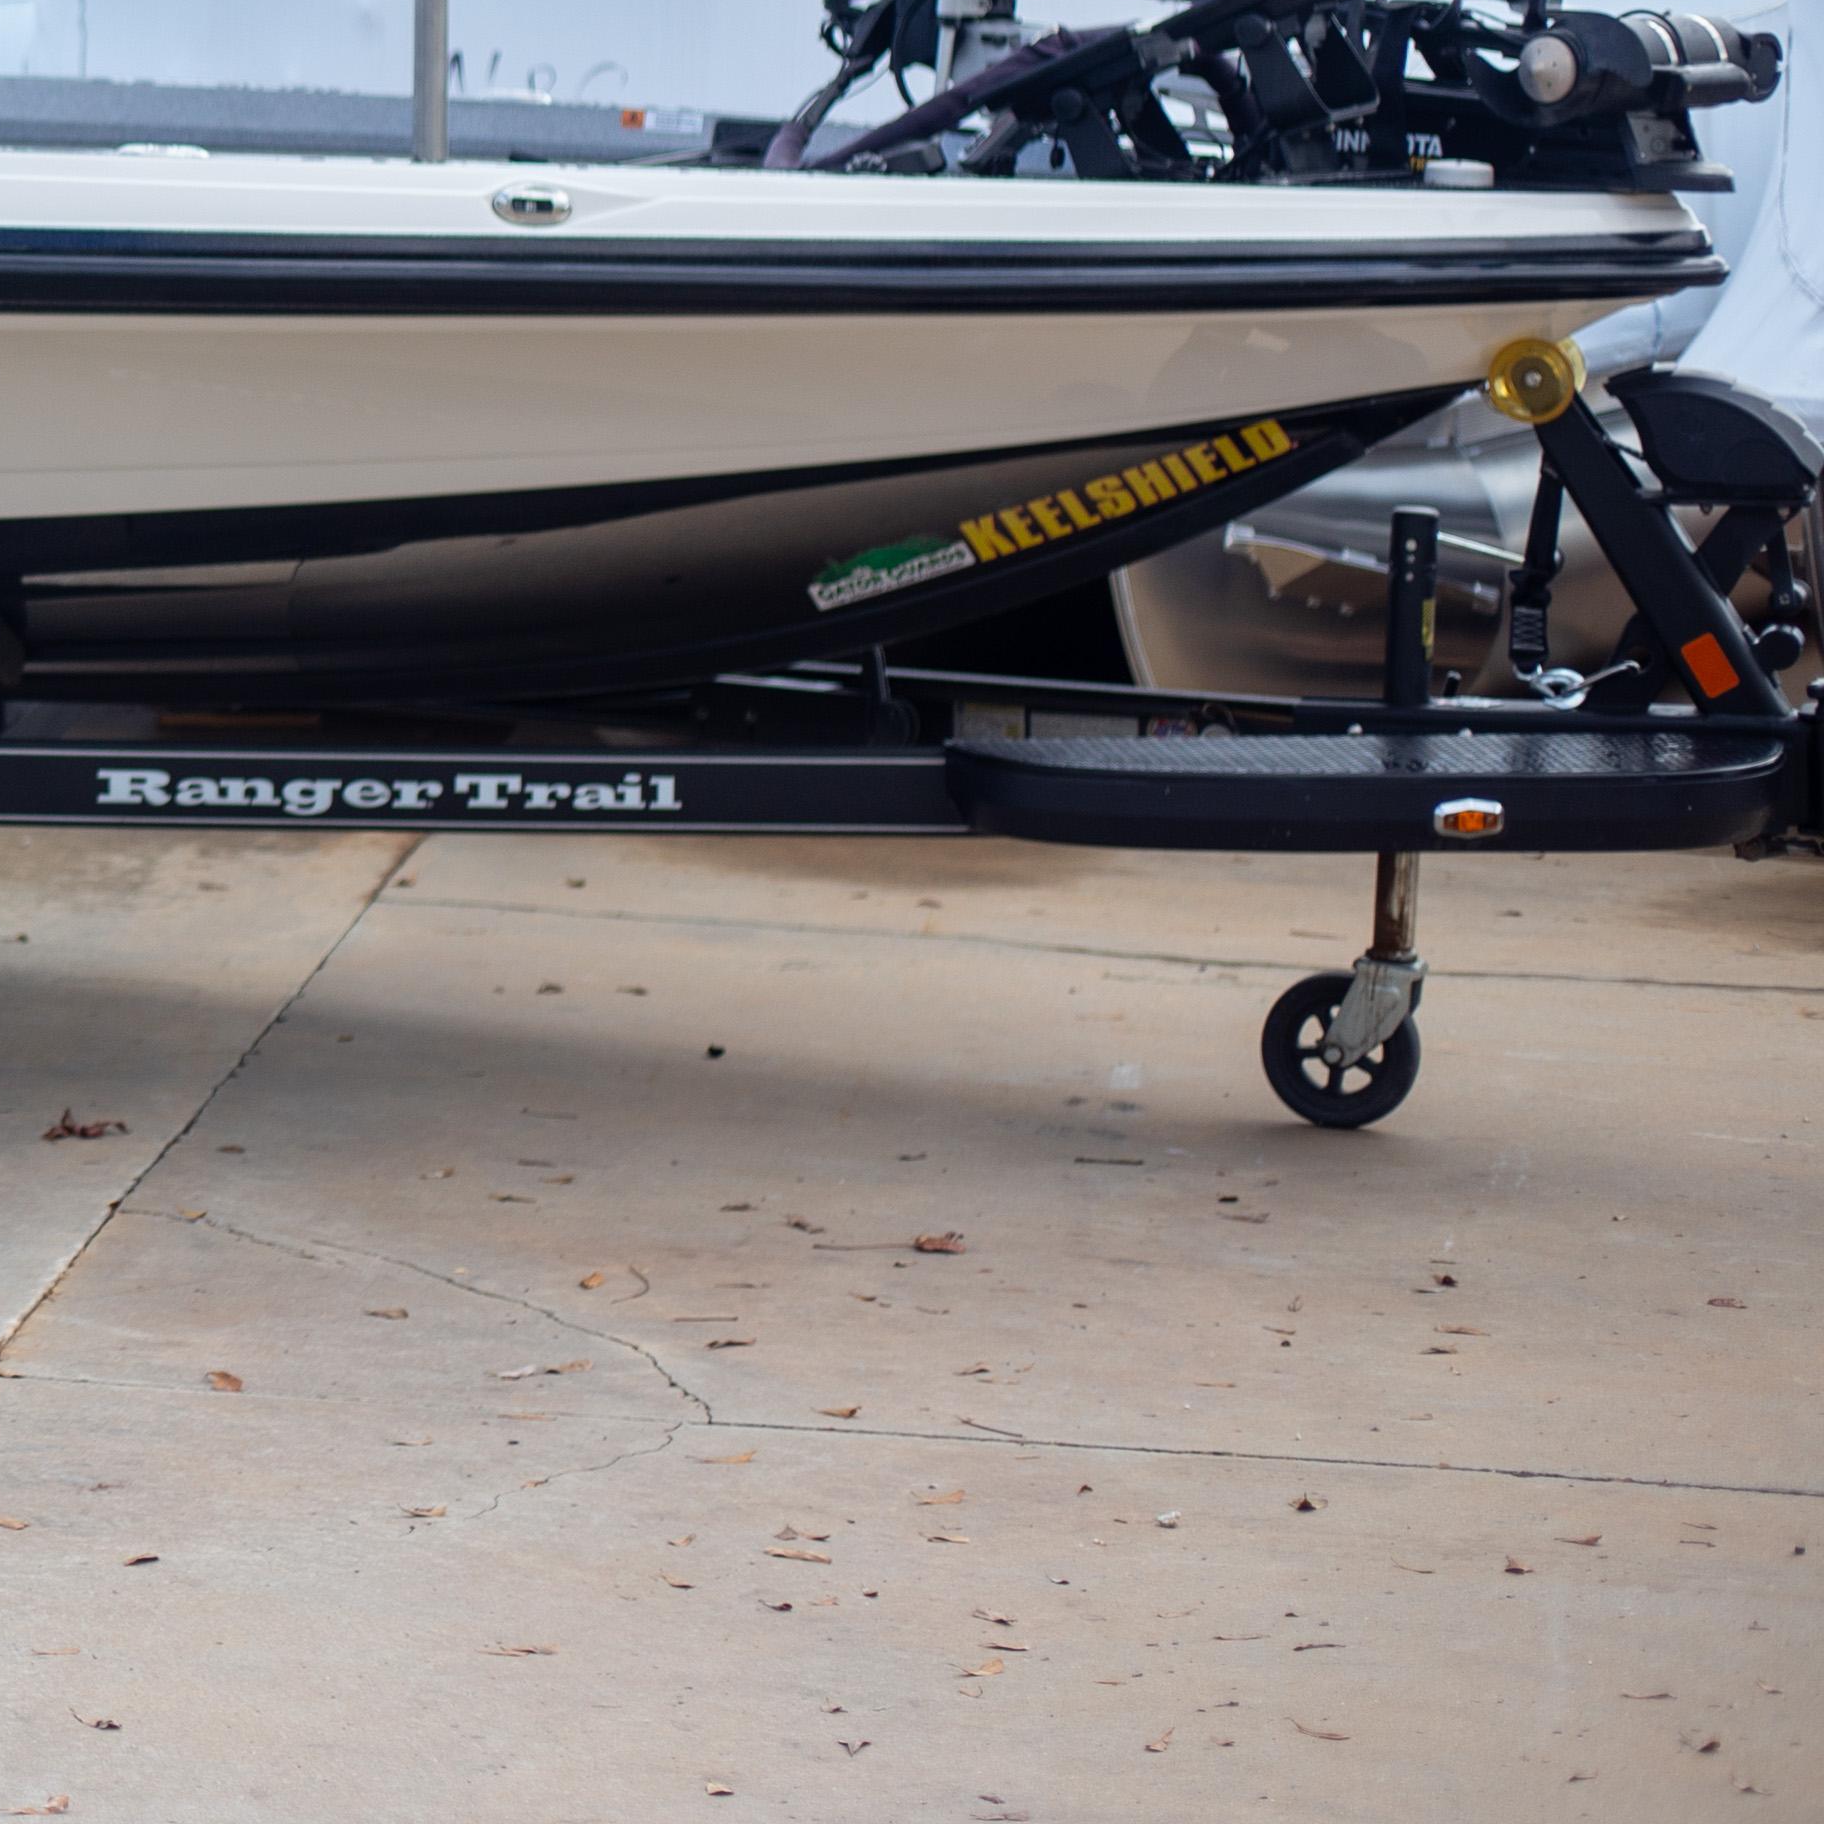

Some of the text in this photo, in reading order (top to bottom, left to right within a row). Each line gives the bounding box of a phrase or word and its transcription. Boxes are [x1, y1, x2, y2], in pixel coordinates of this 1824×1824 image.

[960, 418, 1294, 563] KEELSHIELD
[96, 767, 683, 815] Ranger Trail
